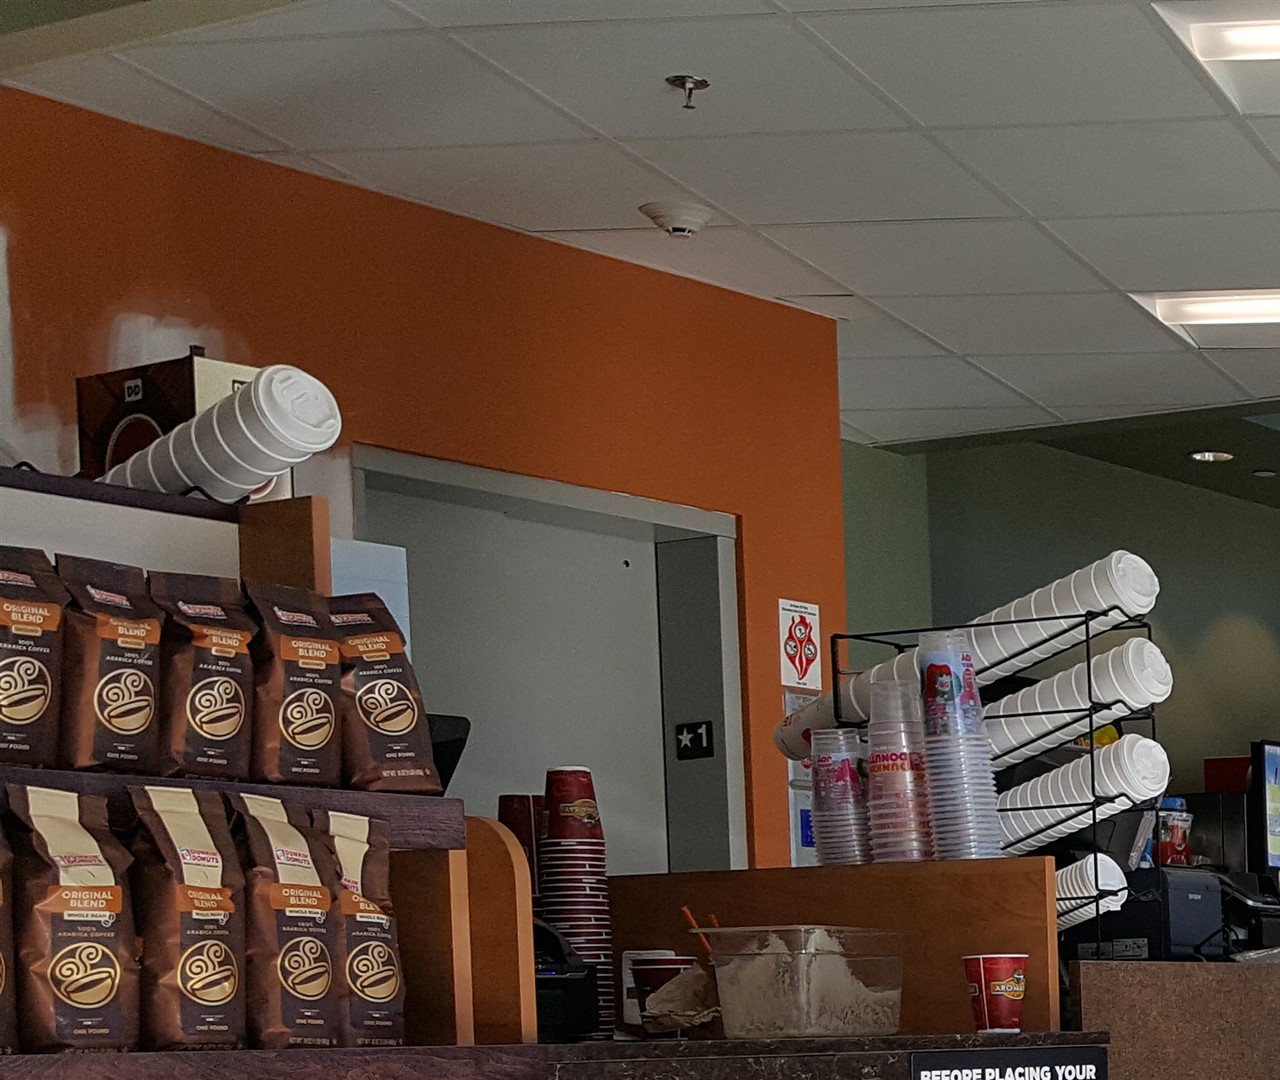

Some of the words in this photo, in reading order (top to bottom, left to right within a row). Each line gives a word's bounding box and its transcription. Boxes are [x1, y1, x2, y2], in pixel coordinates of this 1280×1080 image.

[127, 384, 140, 396] DD
[3, 603, 50, 616] ORIGINAL
[11, 612, 43, 624] BLEND
[118, 626, 146, 636] BLEND
[212, 635, 240, 646] BLEND
[348, 635, 390, 646] ORIGINAL
[291, 640, 332, 652] ORIGINAL
[358, 641, 386, 652] BLEND
[298, 648, 326, 658] BLEND
[698, 724, 707, 747] 1
[192, 856, 219, 864] DONUTS
[286, 856, 310, 866] DONUTS
[62, 890, 114, 900] ORIGINAL
[188, 890, 224, 900] ORIGINAL
[282, 888, 322, 898] ORIGINAL
[70, 899, 107, 908] BLEND
[194, 899, 218, 908] BLEND
[290, 896, 318, 906] BLEND
[1054, 1064, 1096, 1080] YOUR
